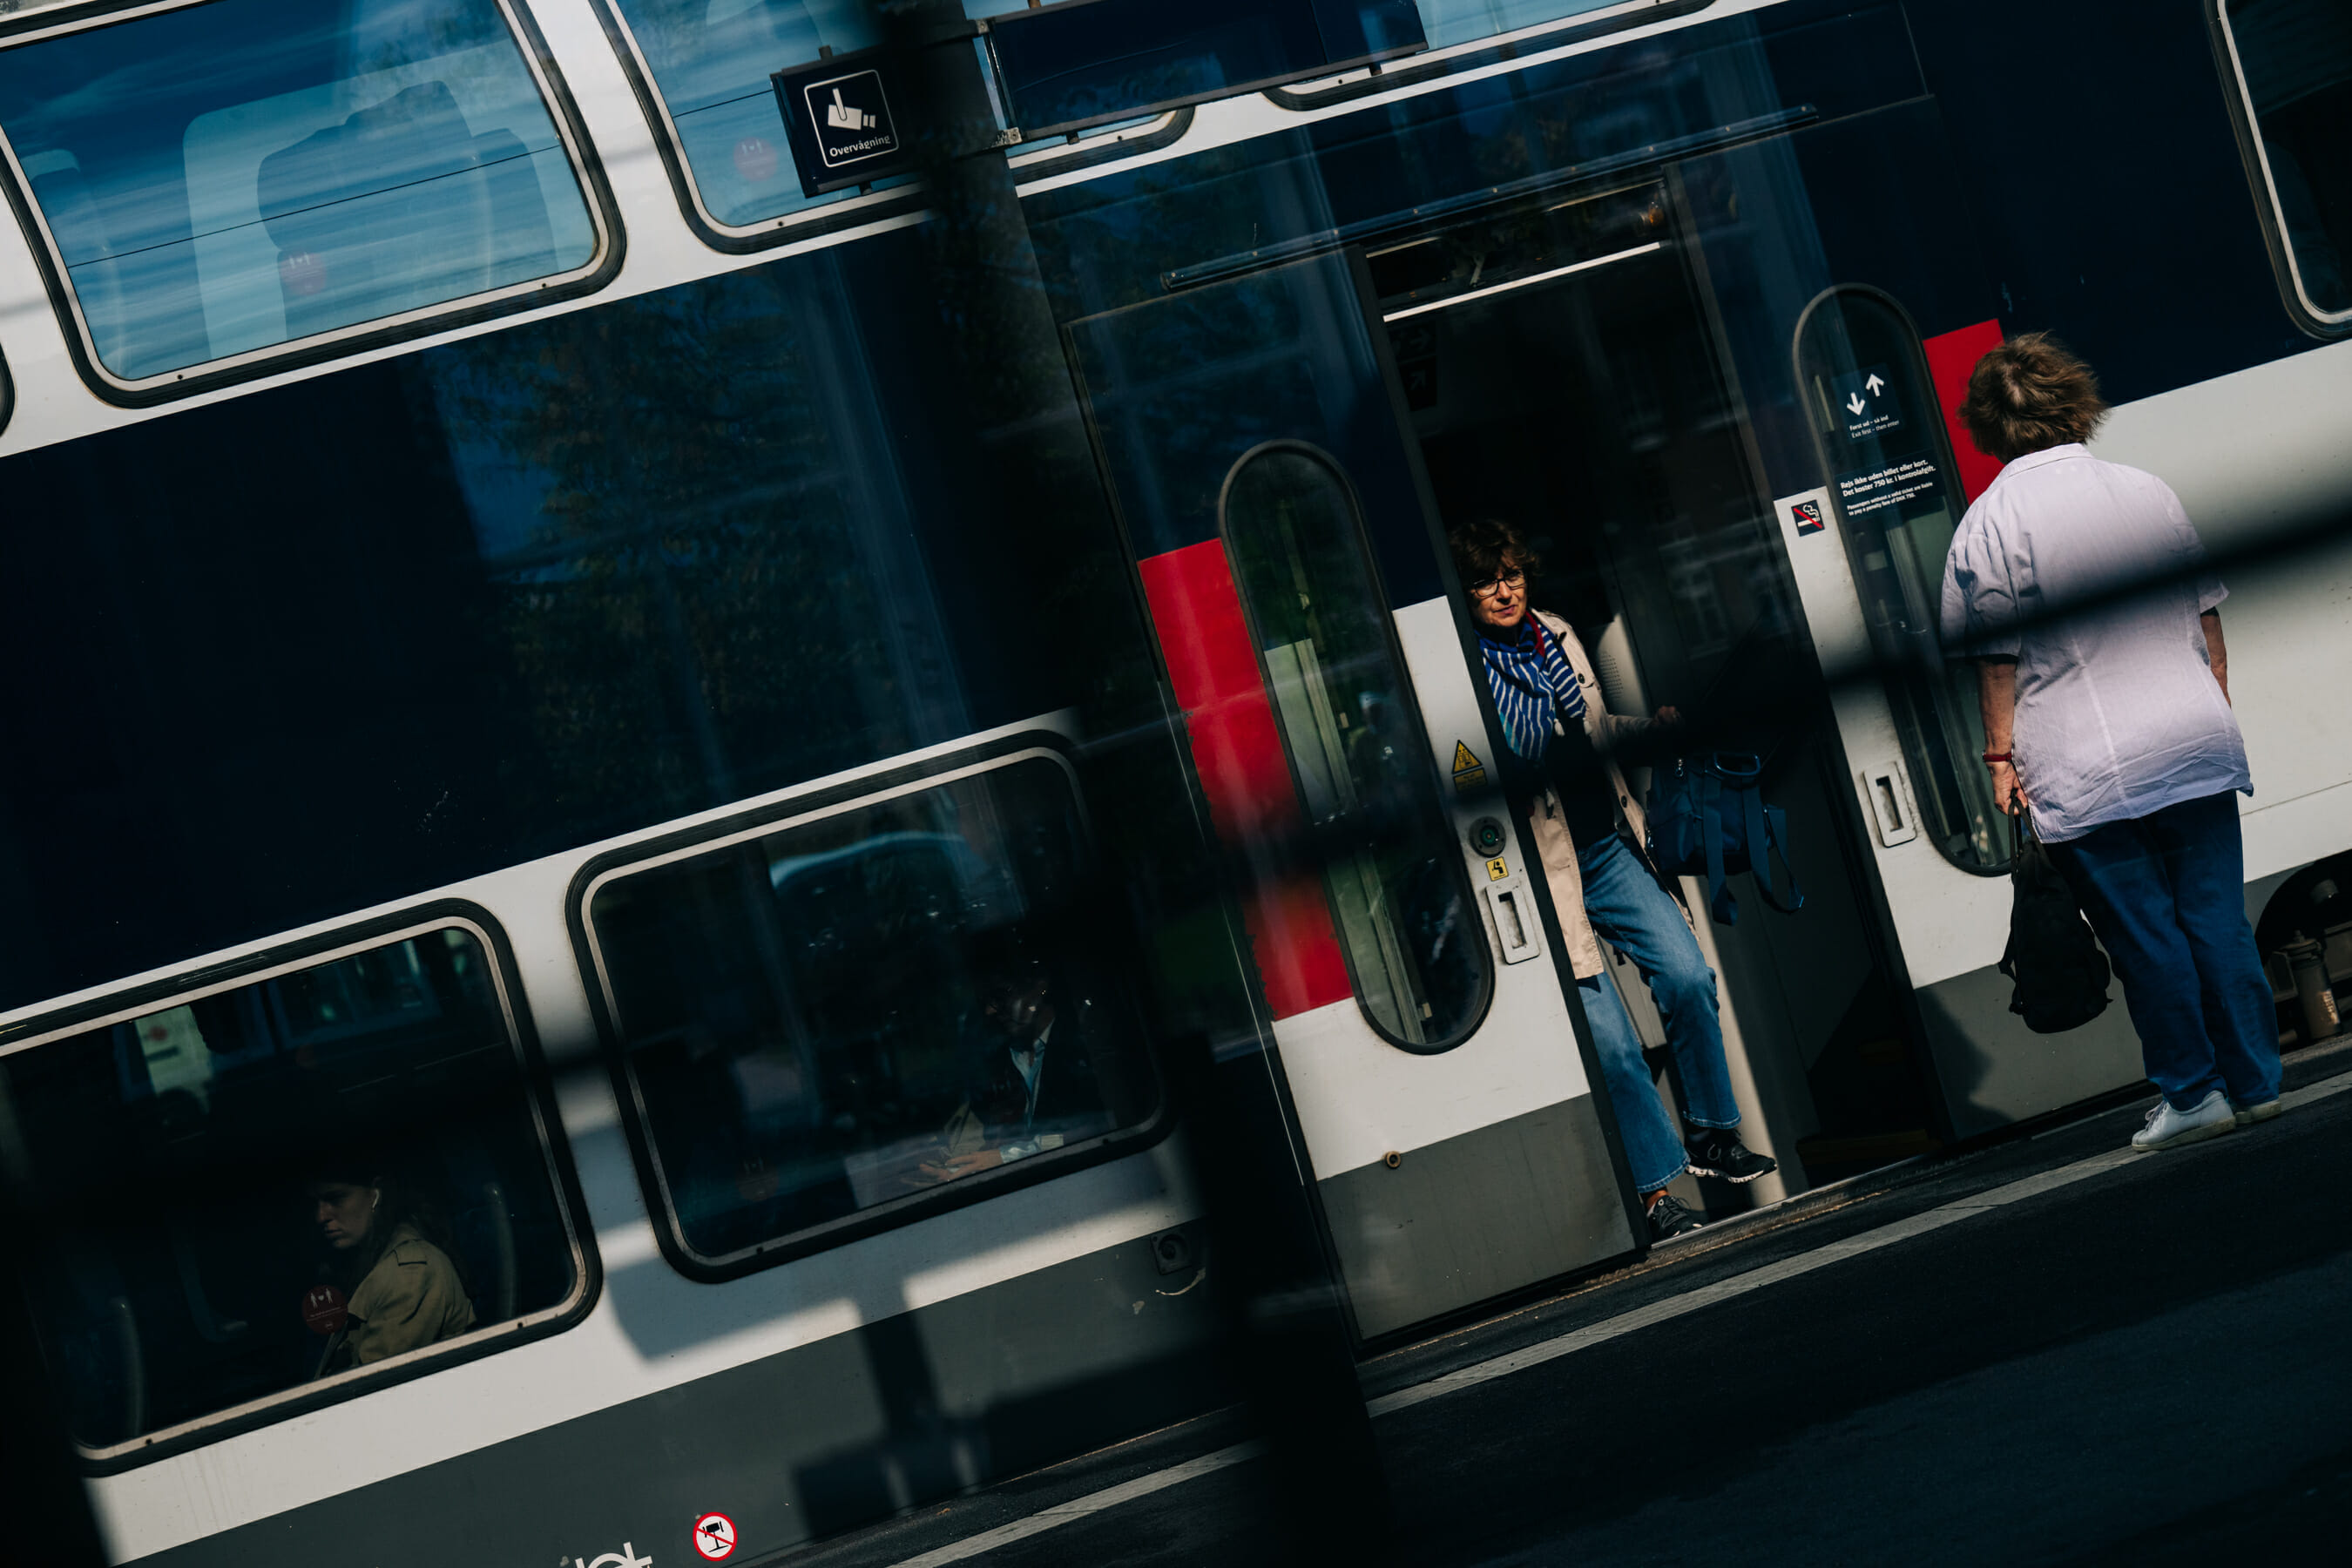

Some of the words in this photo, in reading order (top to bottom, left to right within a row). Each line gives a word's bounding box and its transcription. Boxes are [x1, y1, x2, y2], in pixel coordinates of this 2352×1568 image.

[829, 135, 891, 157] Overvågning
[1840, 480, 1854, 489] Rejs
[1868, 472, 1883, 481] uden
[1882, 467, 1899, 476] billet
[1854, 483, 1873, 493] koster
[1873, 478, 1886, 488] 750
[1866, 503, 1882, 511] penalty
[1870, 495, 1887, 504] without
